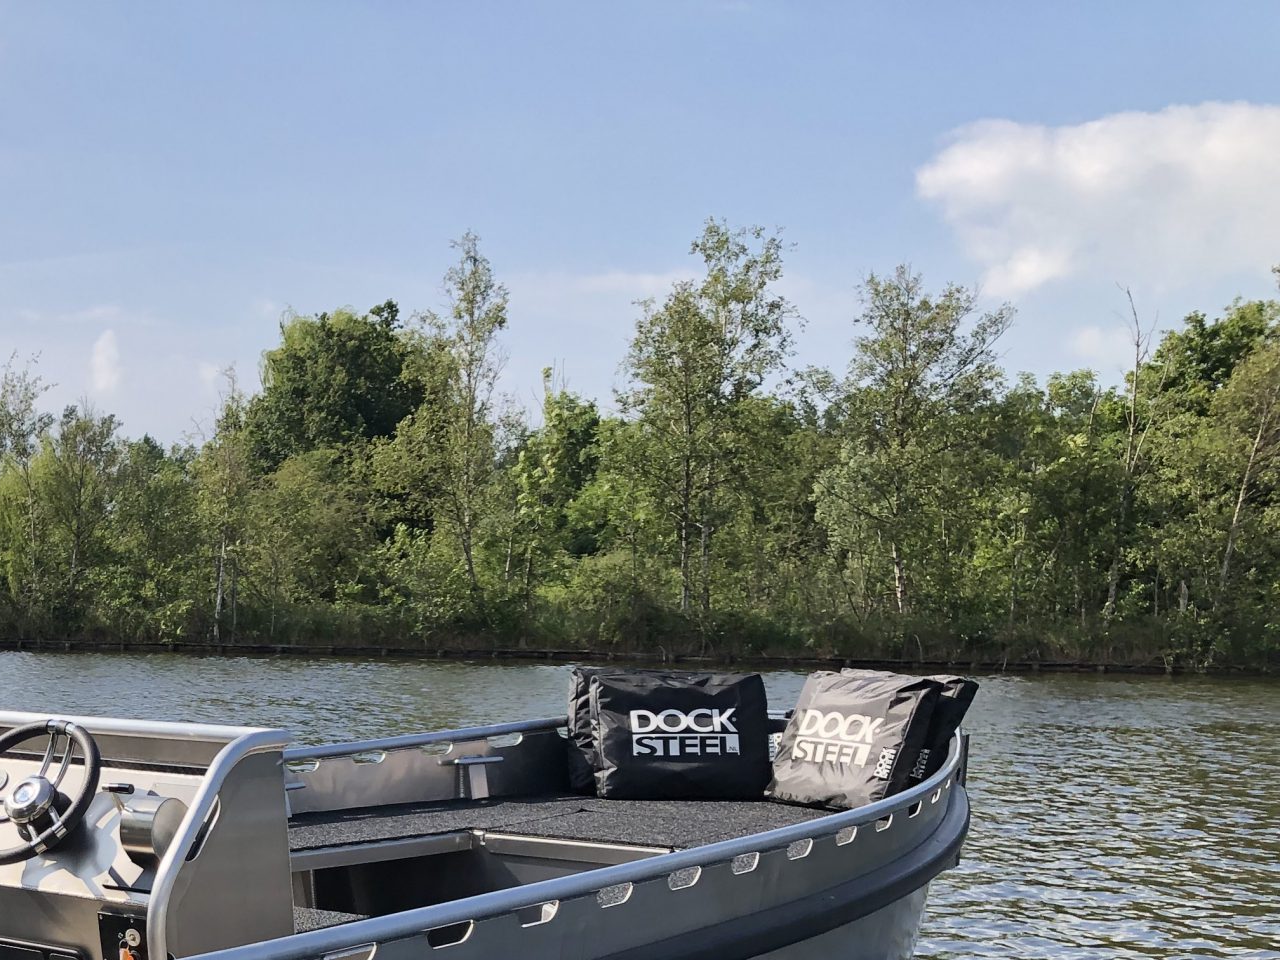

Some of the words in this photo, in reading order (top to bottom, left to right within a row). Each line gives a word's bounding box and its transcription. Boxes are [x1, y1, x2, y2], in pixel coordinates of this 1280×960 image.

[630, 708, 738, 733] DOCK
[798, 709, 885, 743] DOCK
[632, 734, 740, 756] STEEL
[792, 736, 873, 769] STEEL
